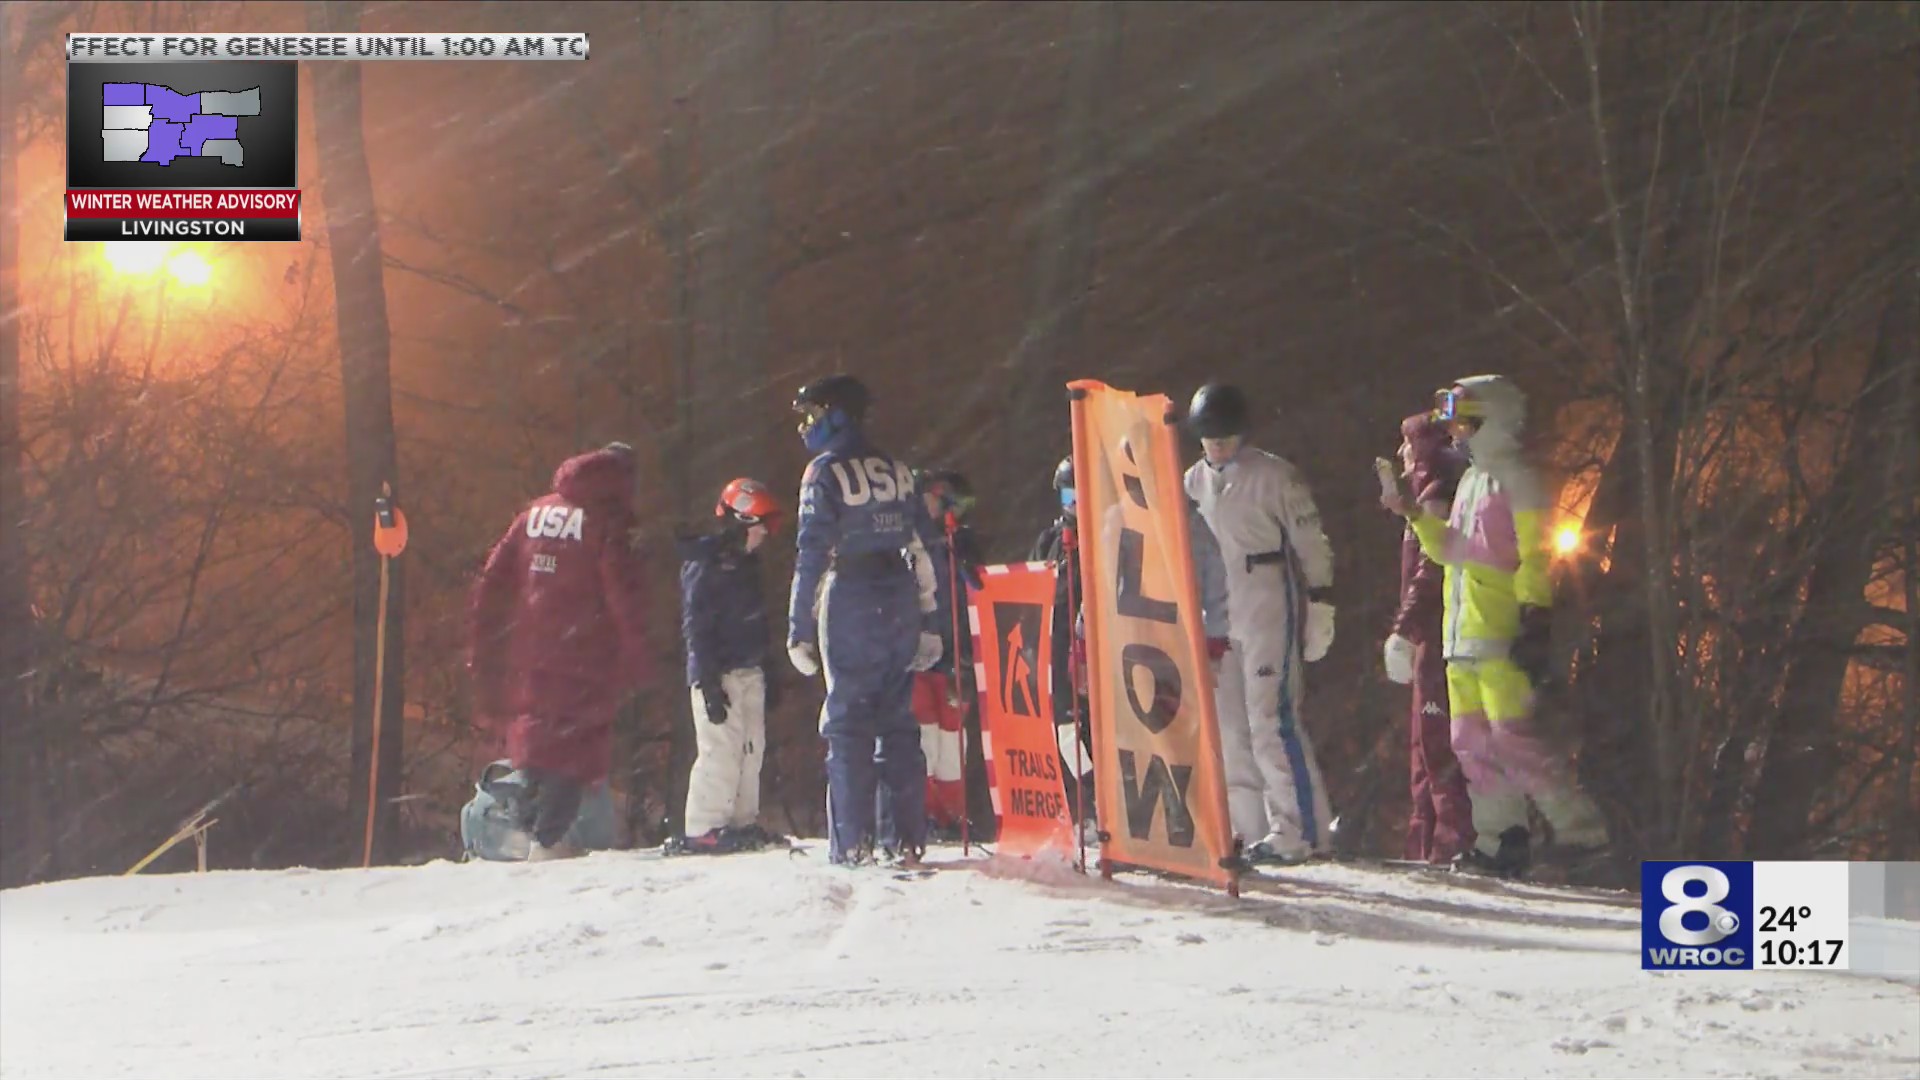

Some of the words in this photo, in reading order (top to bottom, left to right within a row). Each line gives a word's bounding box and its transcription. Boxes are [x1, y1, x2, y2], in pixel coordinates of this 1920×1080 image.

[831, 456, 914, 507] USA
[526, 505, 584, 540] USA
[1005, 748, 1057, 781] TRAILS
[1010, 788, 1065, 820] MERGE
